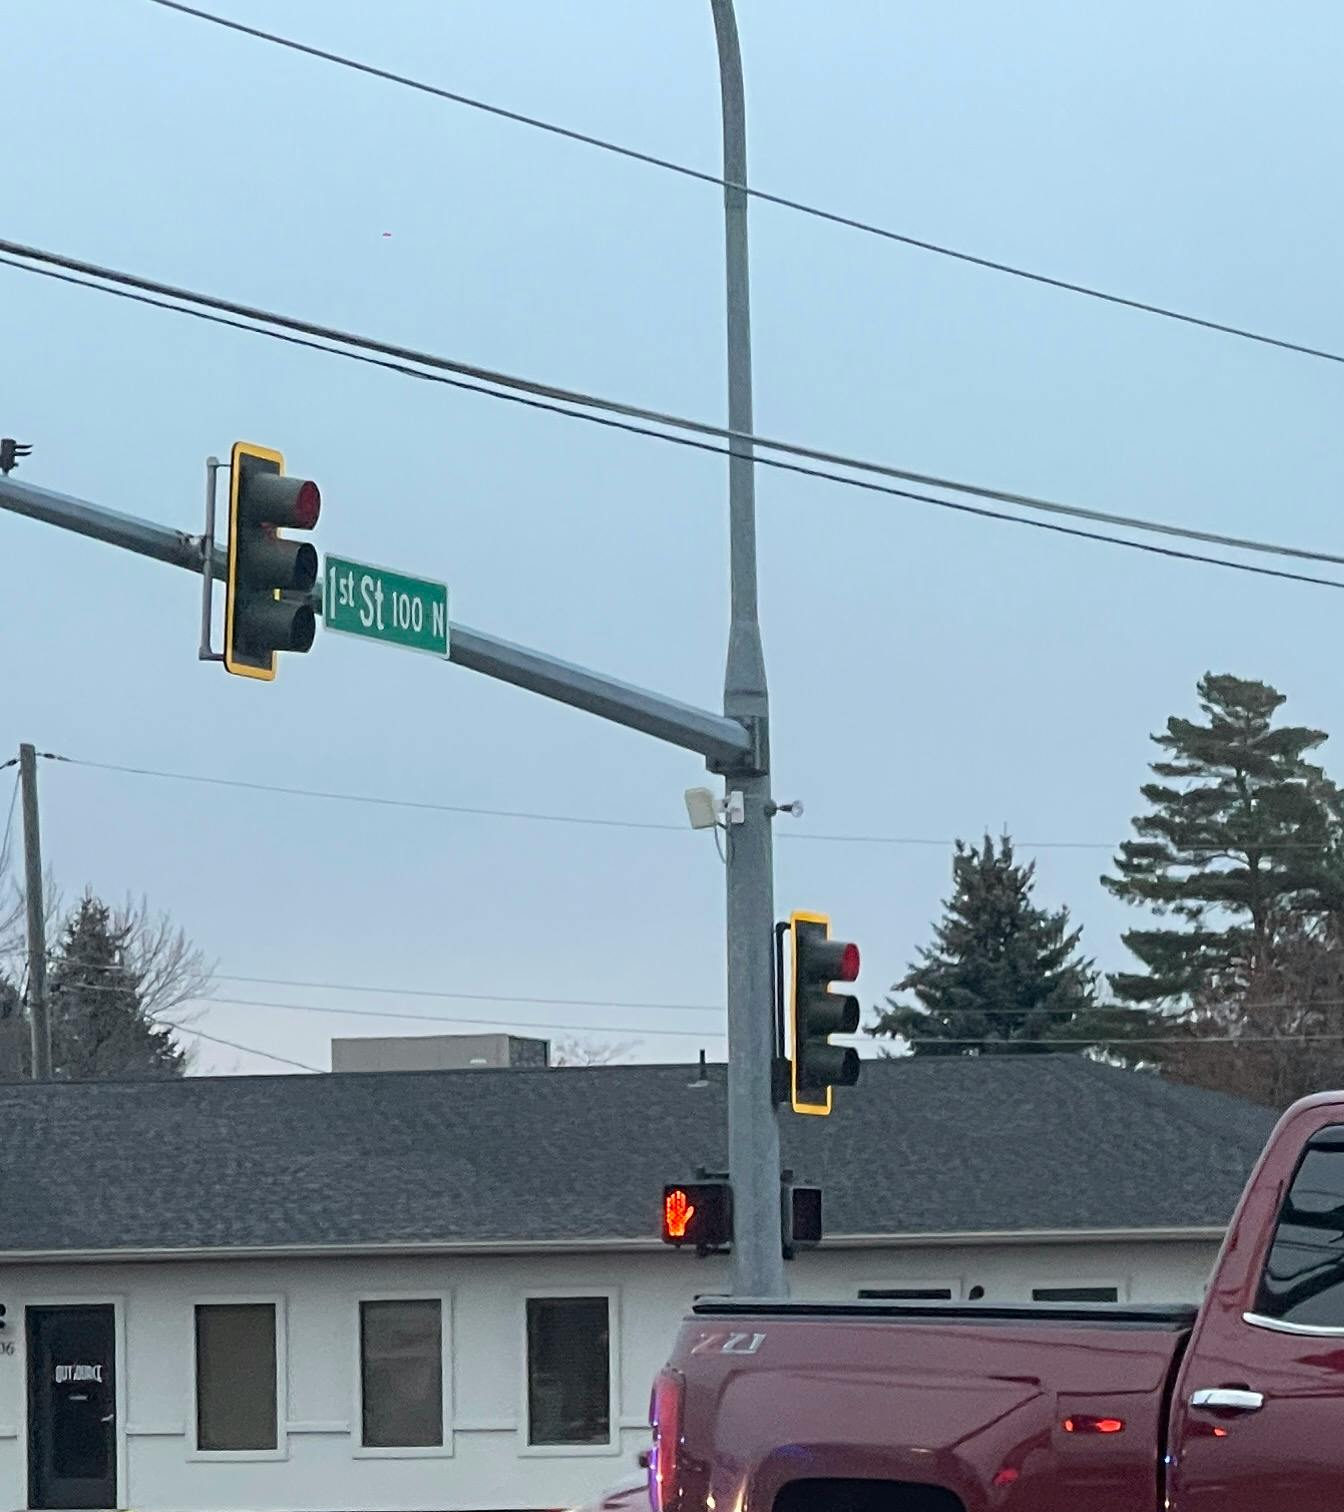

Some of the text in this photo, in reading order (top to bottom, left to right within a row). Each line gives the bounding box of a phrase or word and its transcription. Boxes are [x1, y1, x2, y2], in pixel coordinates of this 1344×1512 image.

[329, 566, 444, 638] 1st St 100 N
[690, 1332, 767, 1354] Z71
